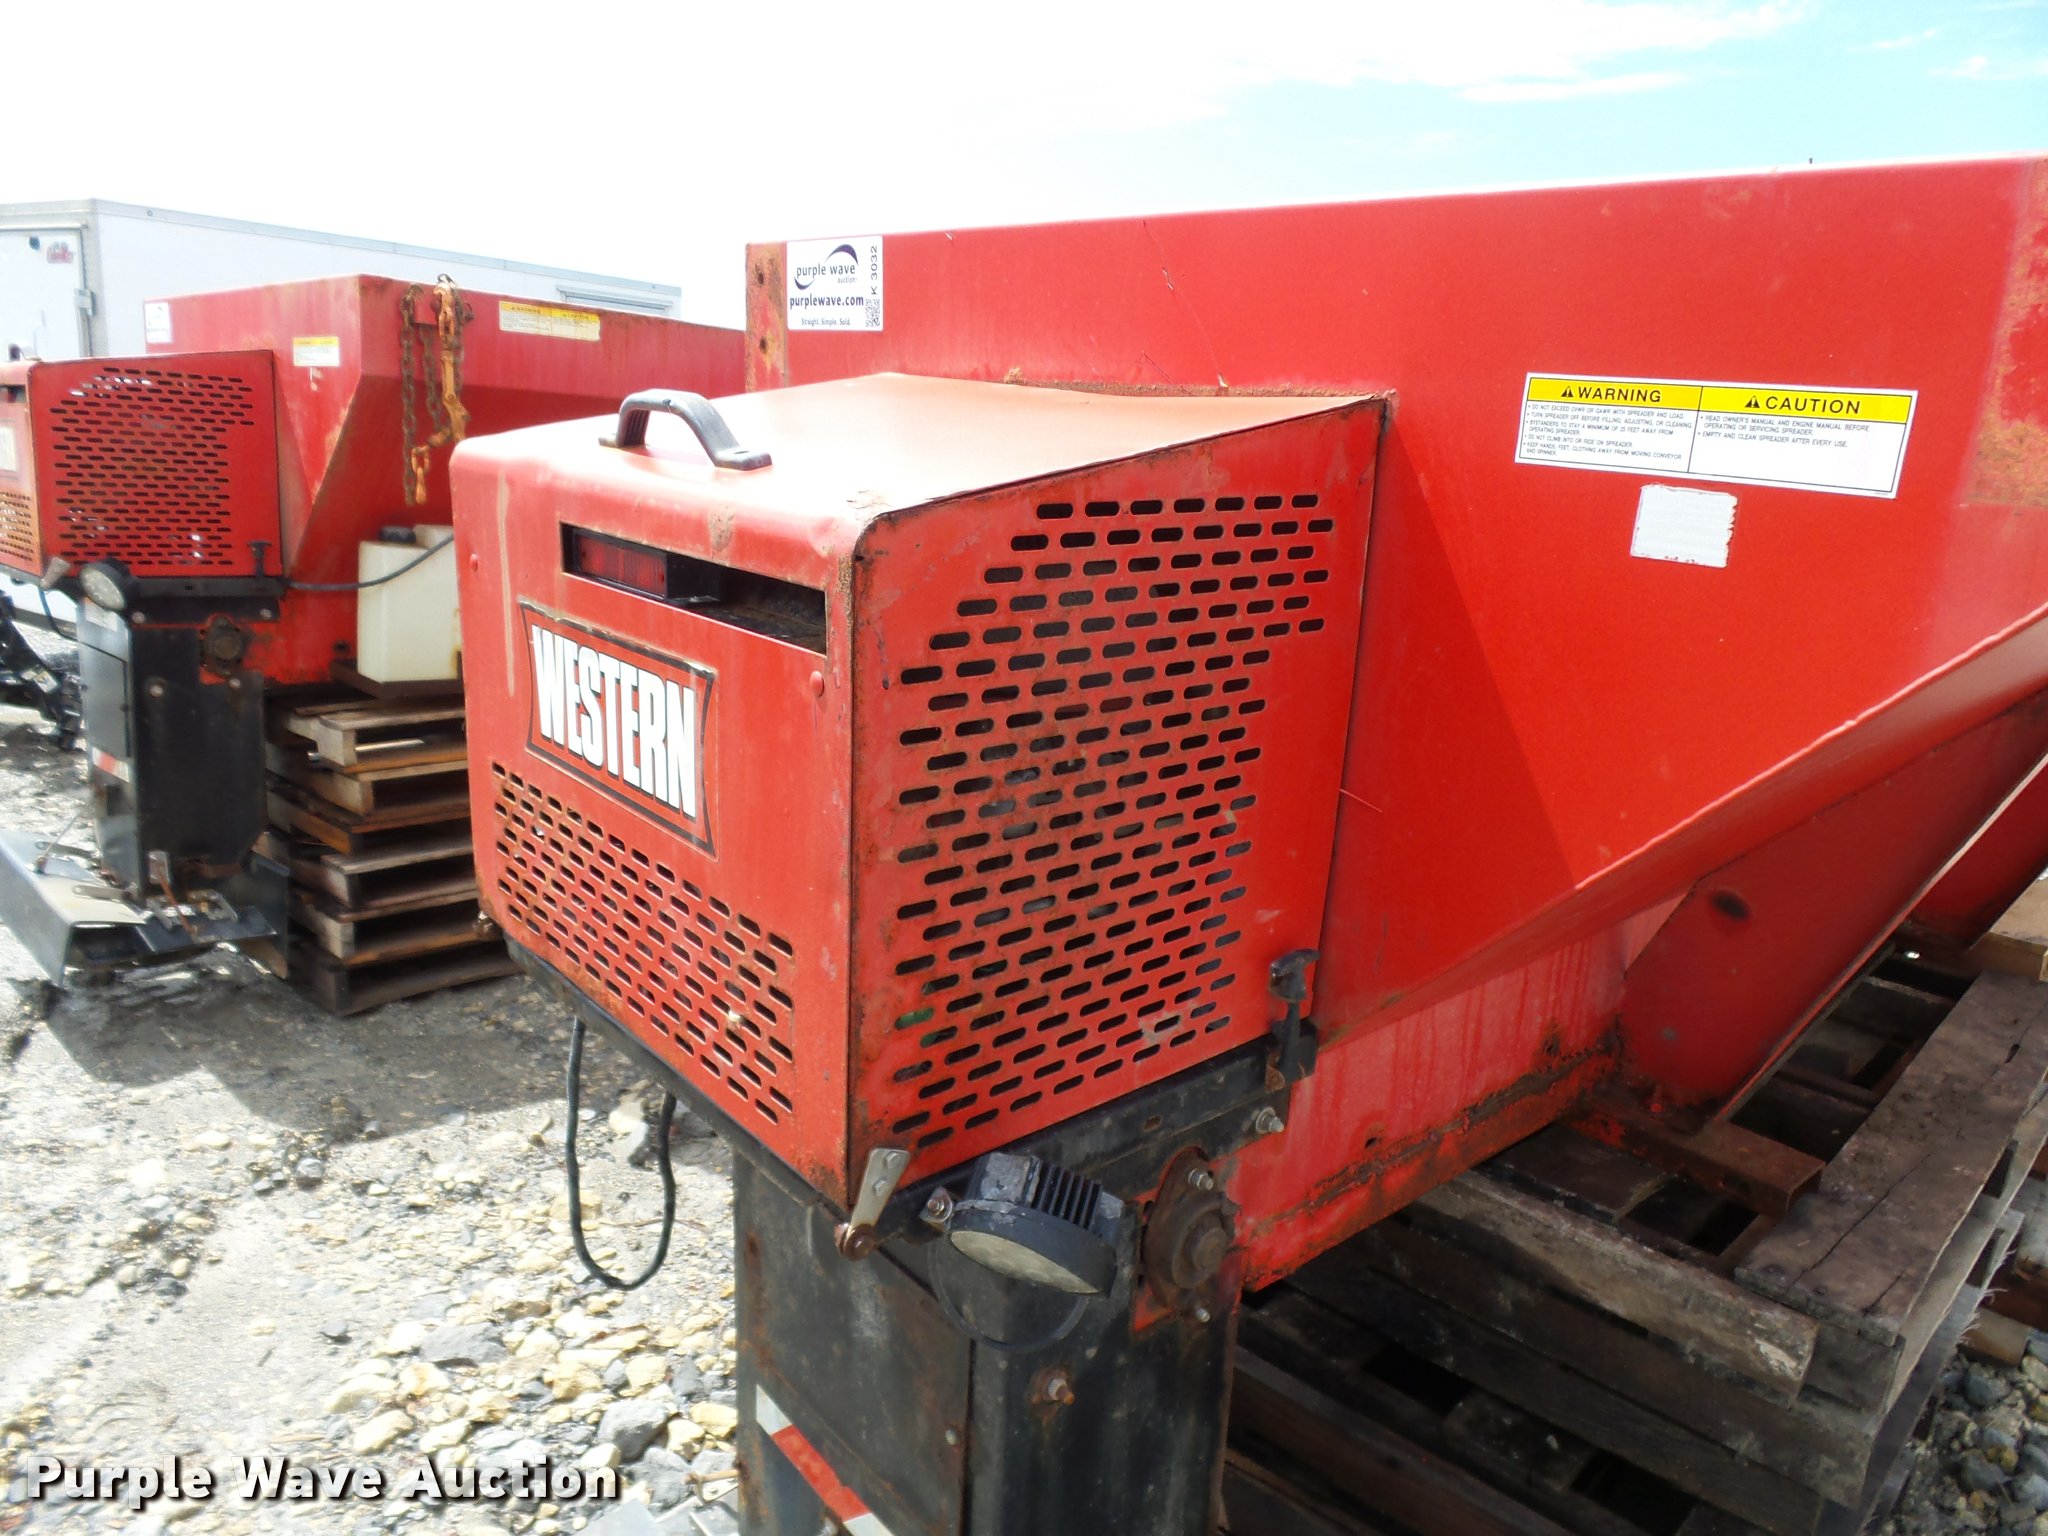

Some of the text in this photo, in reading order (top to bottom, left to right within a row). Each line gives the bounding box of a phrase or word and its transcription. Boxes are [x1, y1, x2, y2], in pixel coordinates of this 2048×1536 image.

[796, 264, 855, 278] purple wave
[871, 286, 877, 295] K
[789, 293, 864, 310] purplewave.com
[1577, 386, 1662, 403] WARNING
[1764, 396, 1861, 415] CAUTION
[531, 624, 697, 822] WESTERN
